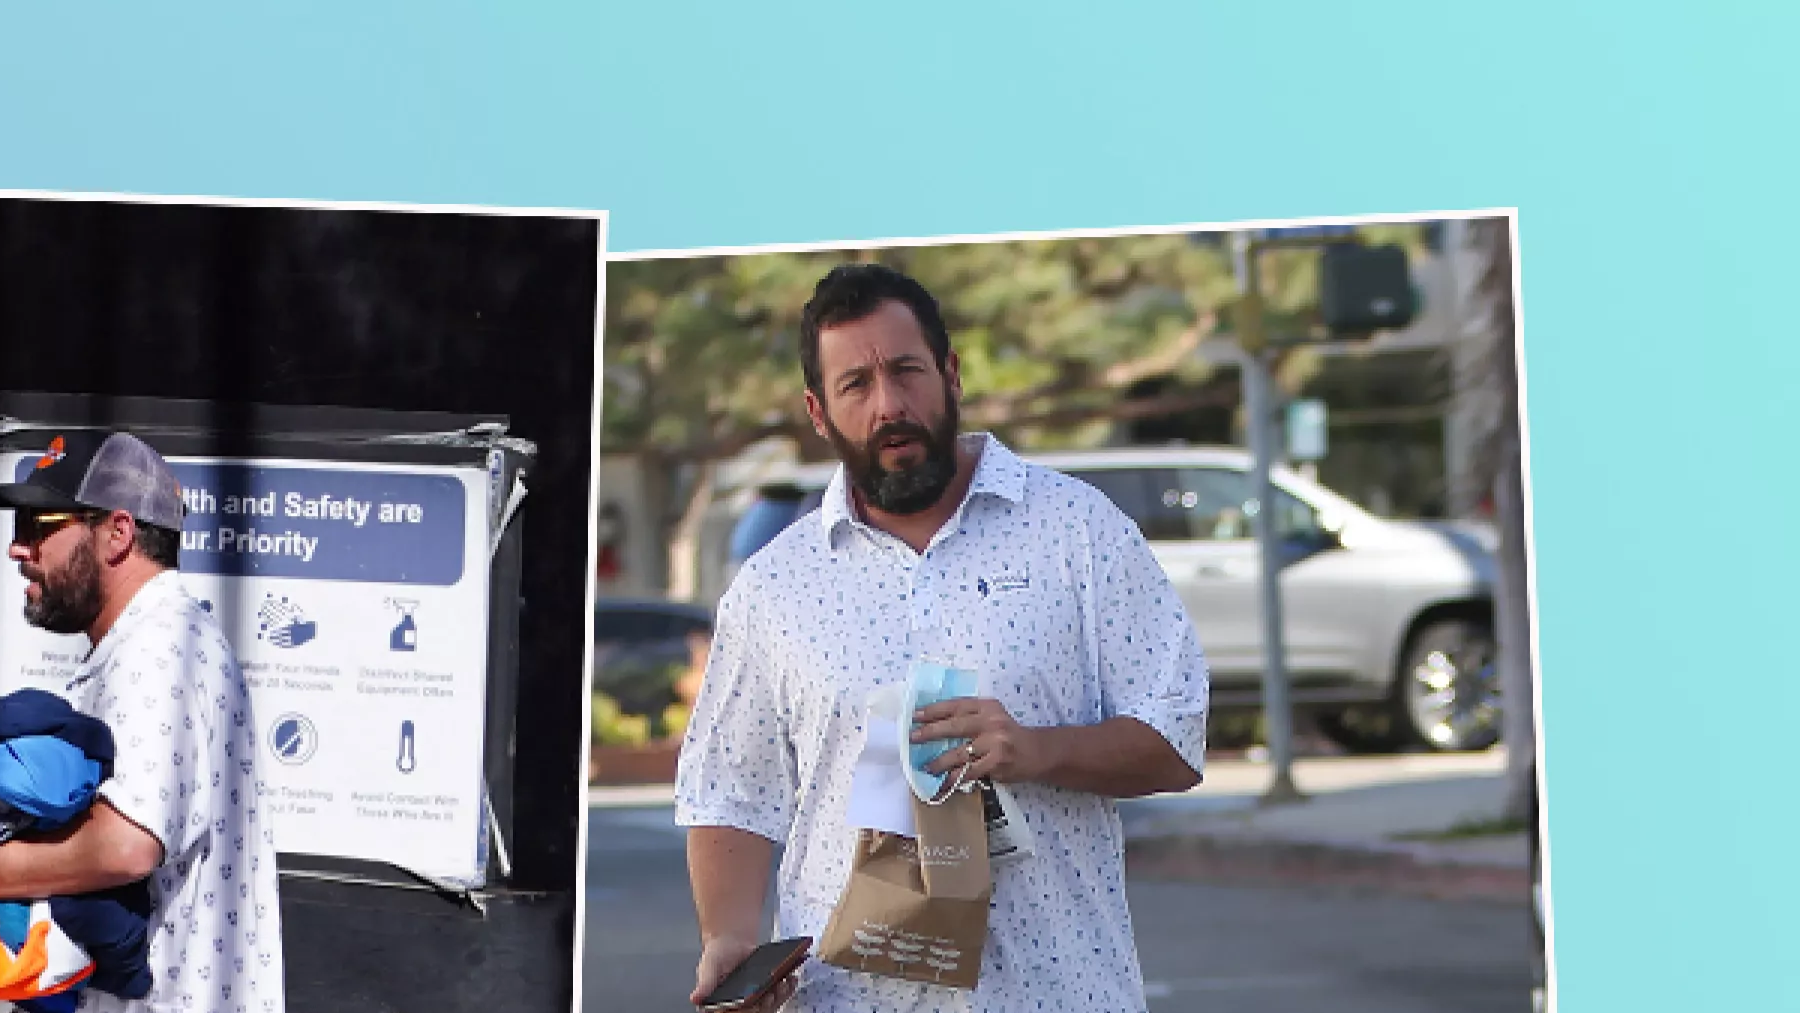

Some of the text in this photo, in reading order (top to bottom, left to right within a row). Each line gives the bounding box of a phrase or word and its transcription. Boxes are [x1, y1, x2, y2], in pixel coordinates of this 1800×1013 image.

[182, 486, 424, 529] lth and Safety are
[181, 527, 319, 562] ur Priority
